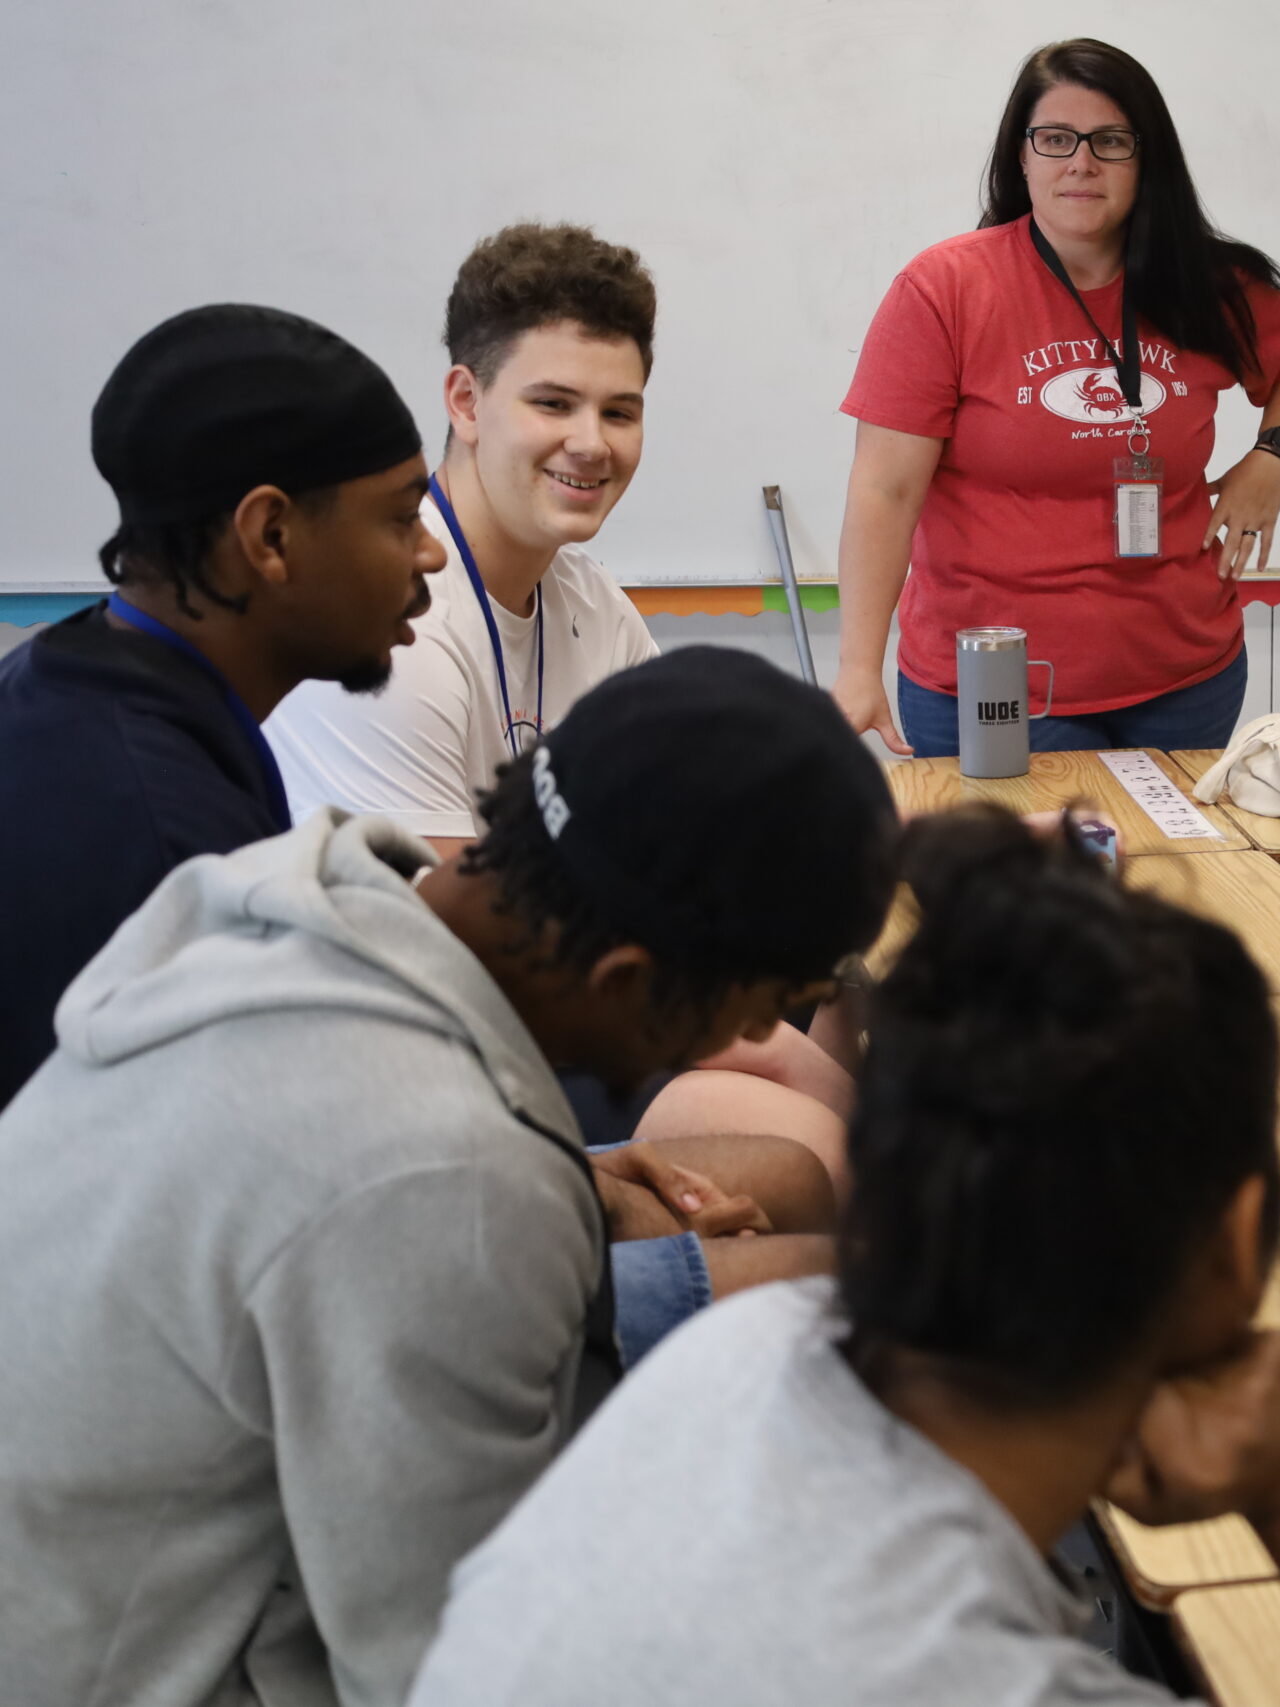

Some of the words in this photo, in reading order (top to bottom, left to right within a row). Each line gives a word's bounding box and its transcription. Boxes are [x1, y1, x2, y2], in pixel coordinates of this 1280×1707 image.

[1022, 338, 1099, 377] KITTY
[1103, 338, 1177, 374] HWK
[1017, 386, 1033, 405] EST
[1096, 392, 1116, 402] OBX
[1071, 427, 1104, 440] North
